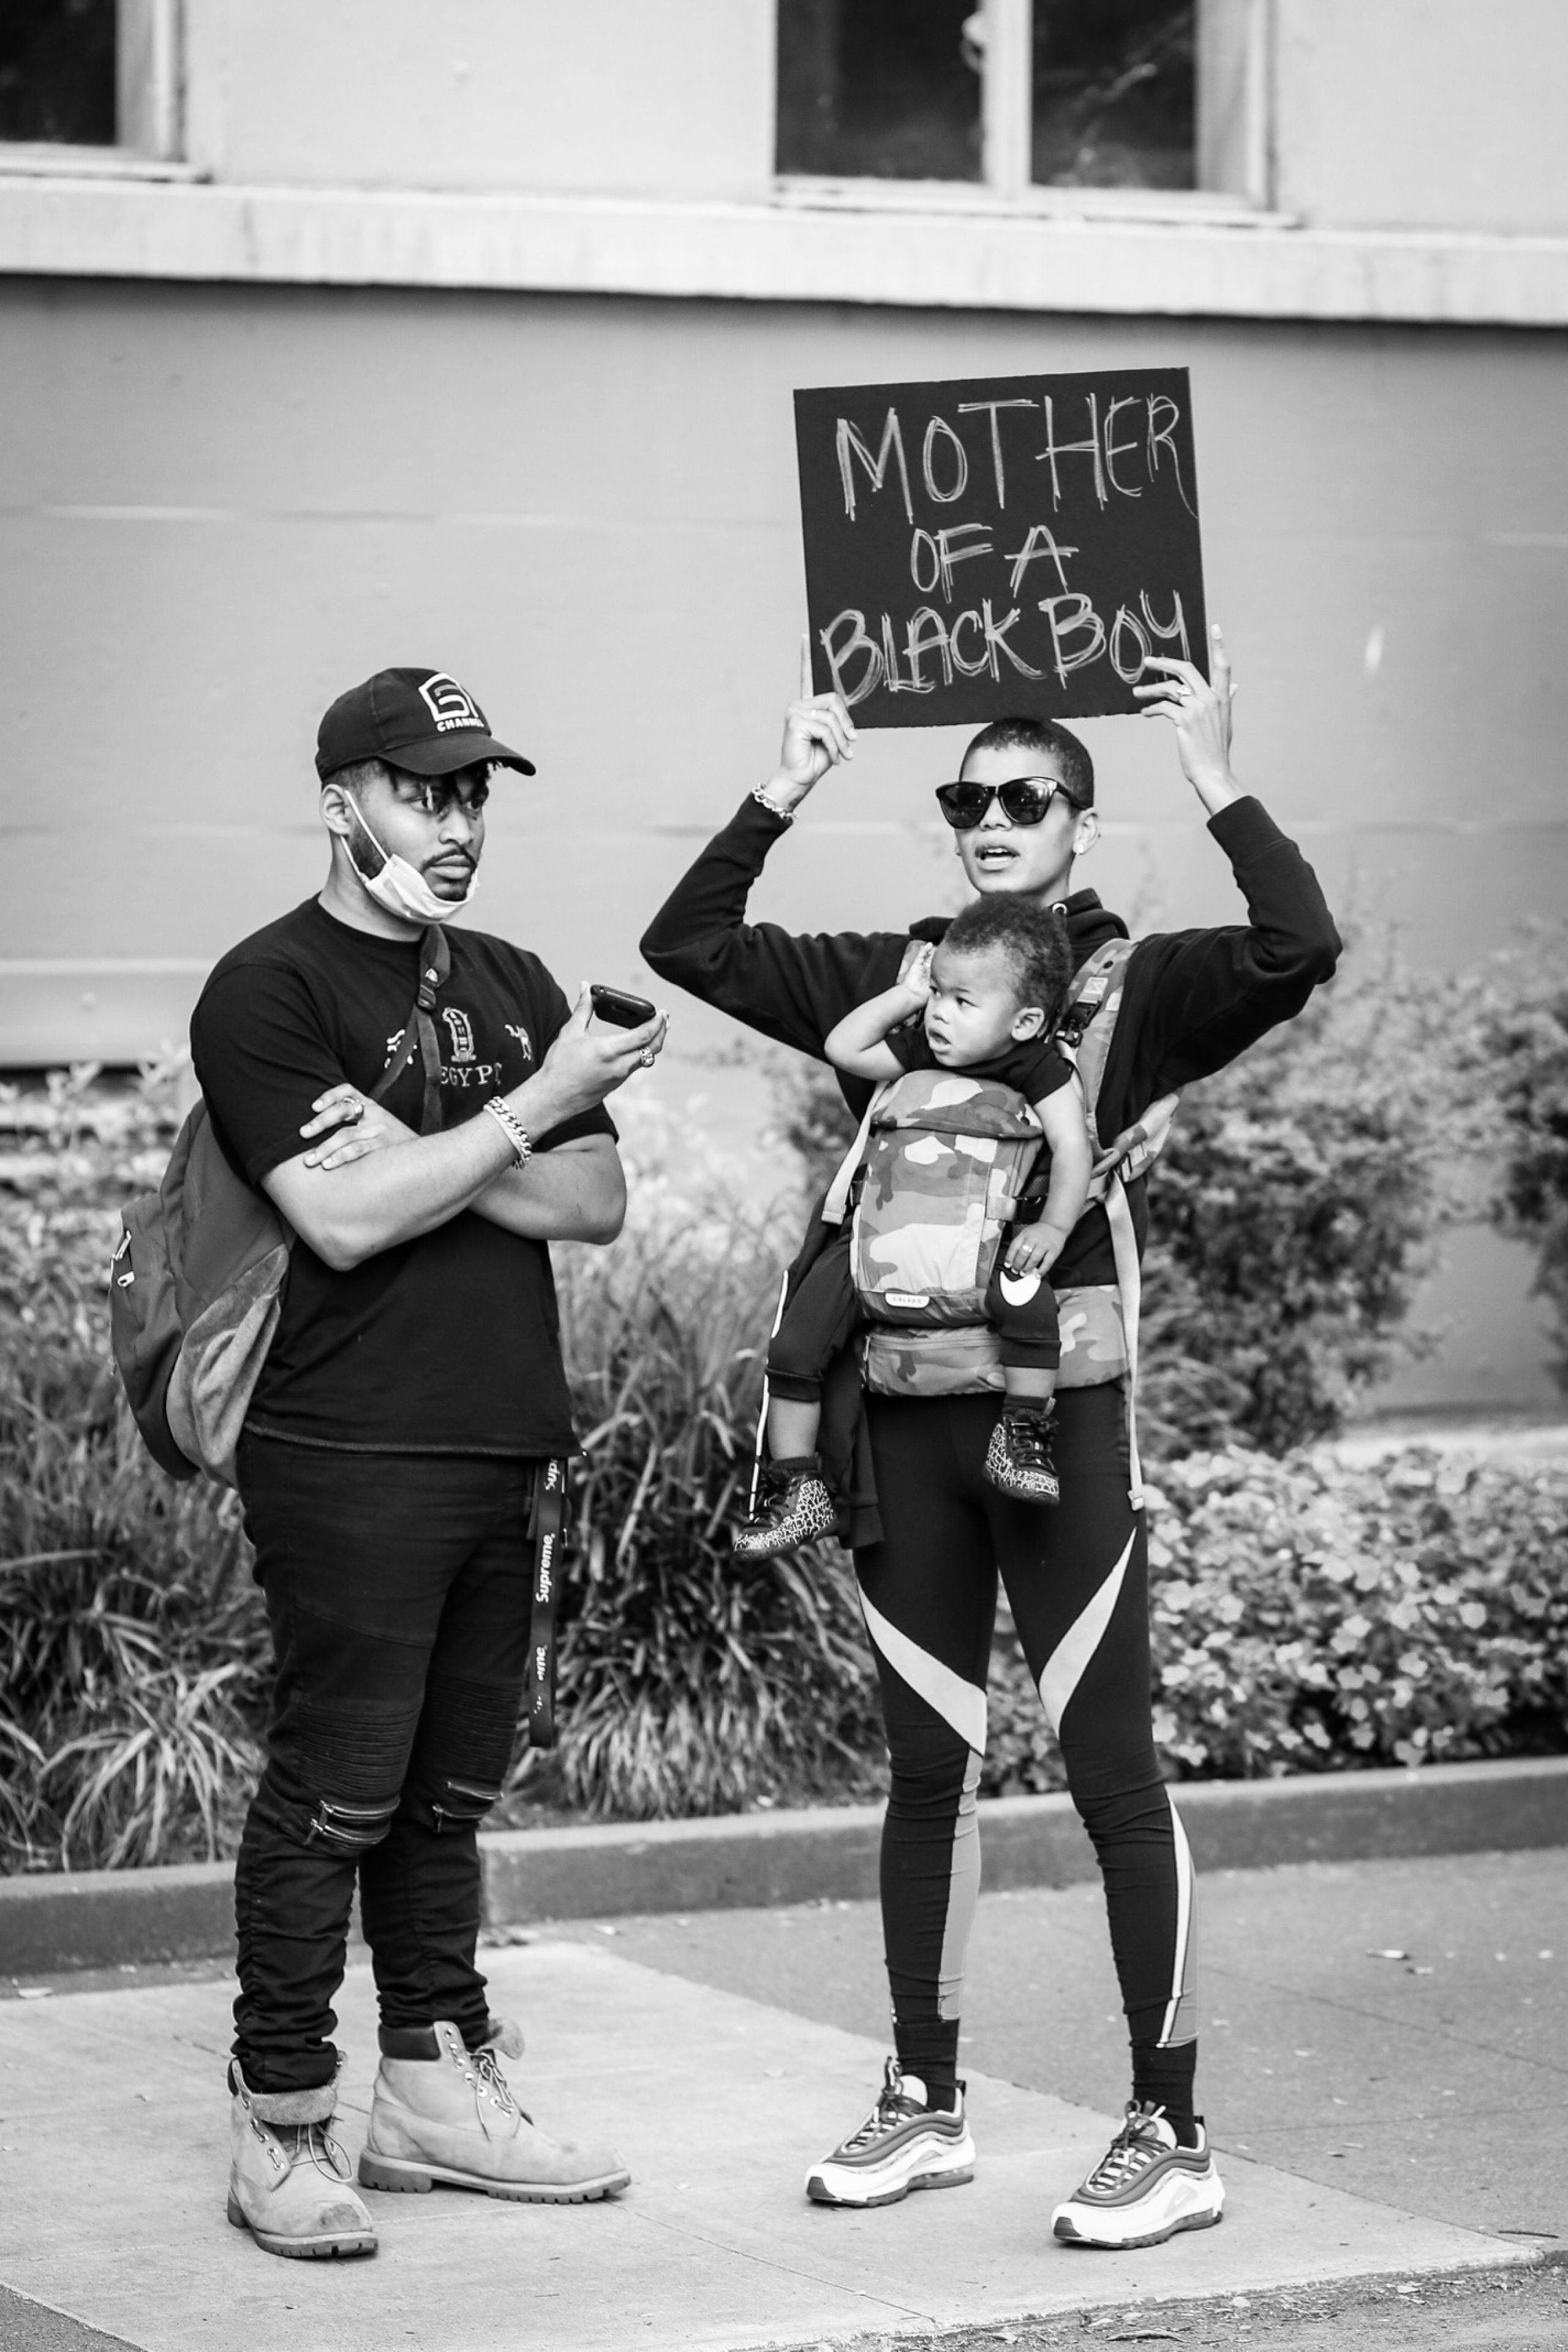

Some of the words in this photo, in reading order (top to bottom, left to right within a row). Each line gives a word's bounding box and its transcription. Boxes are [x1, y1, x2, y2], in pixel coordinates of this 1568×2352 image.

[836, 392, 1199, 525] MOTHER
[910, 522, 993, 603] OF
[1004, 524, 1080, 598] A
[819, 598, 1046, 708] BLACK
[1038, 589, 1191, 689] BOY
[535, 1533, 556, 1603] Supreme
